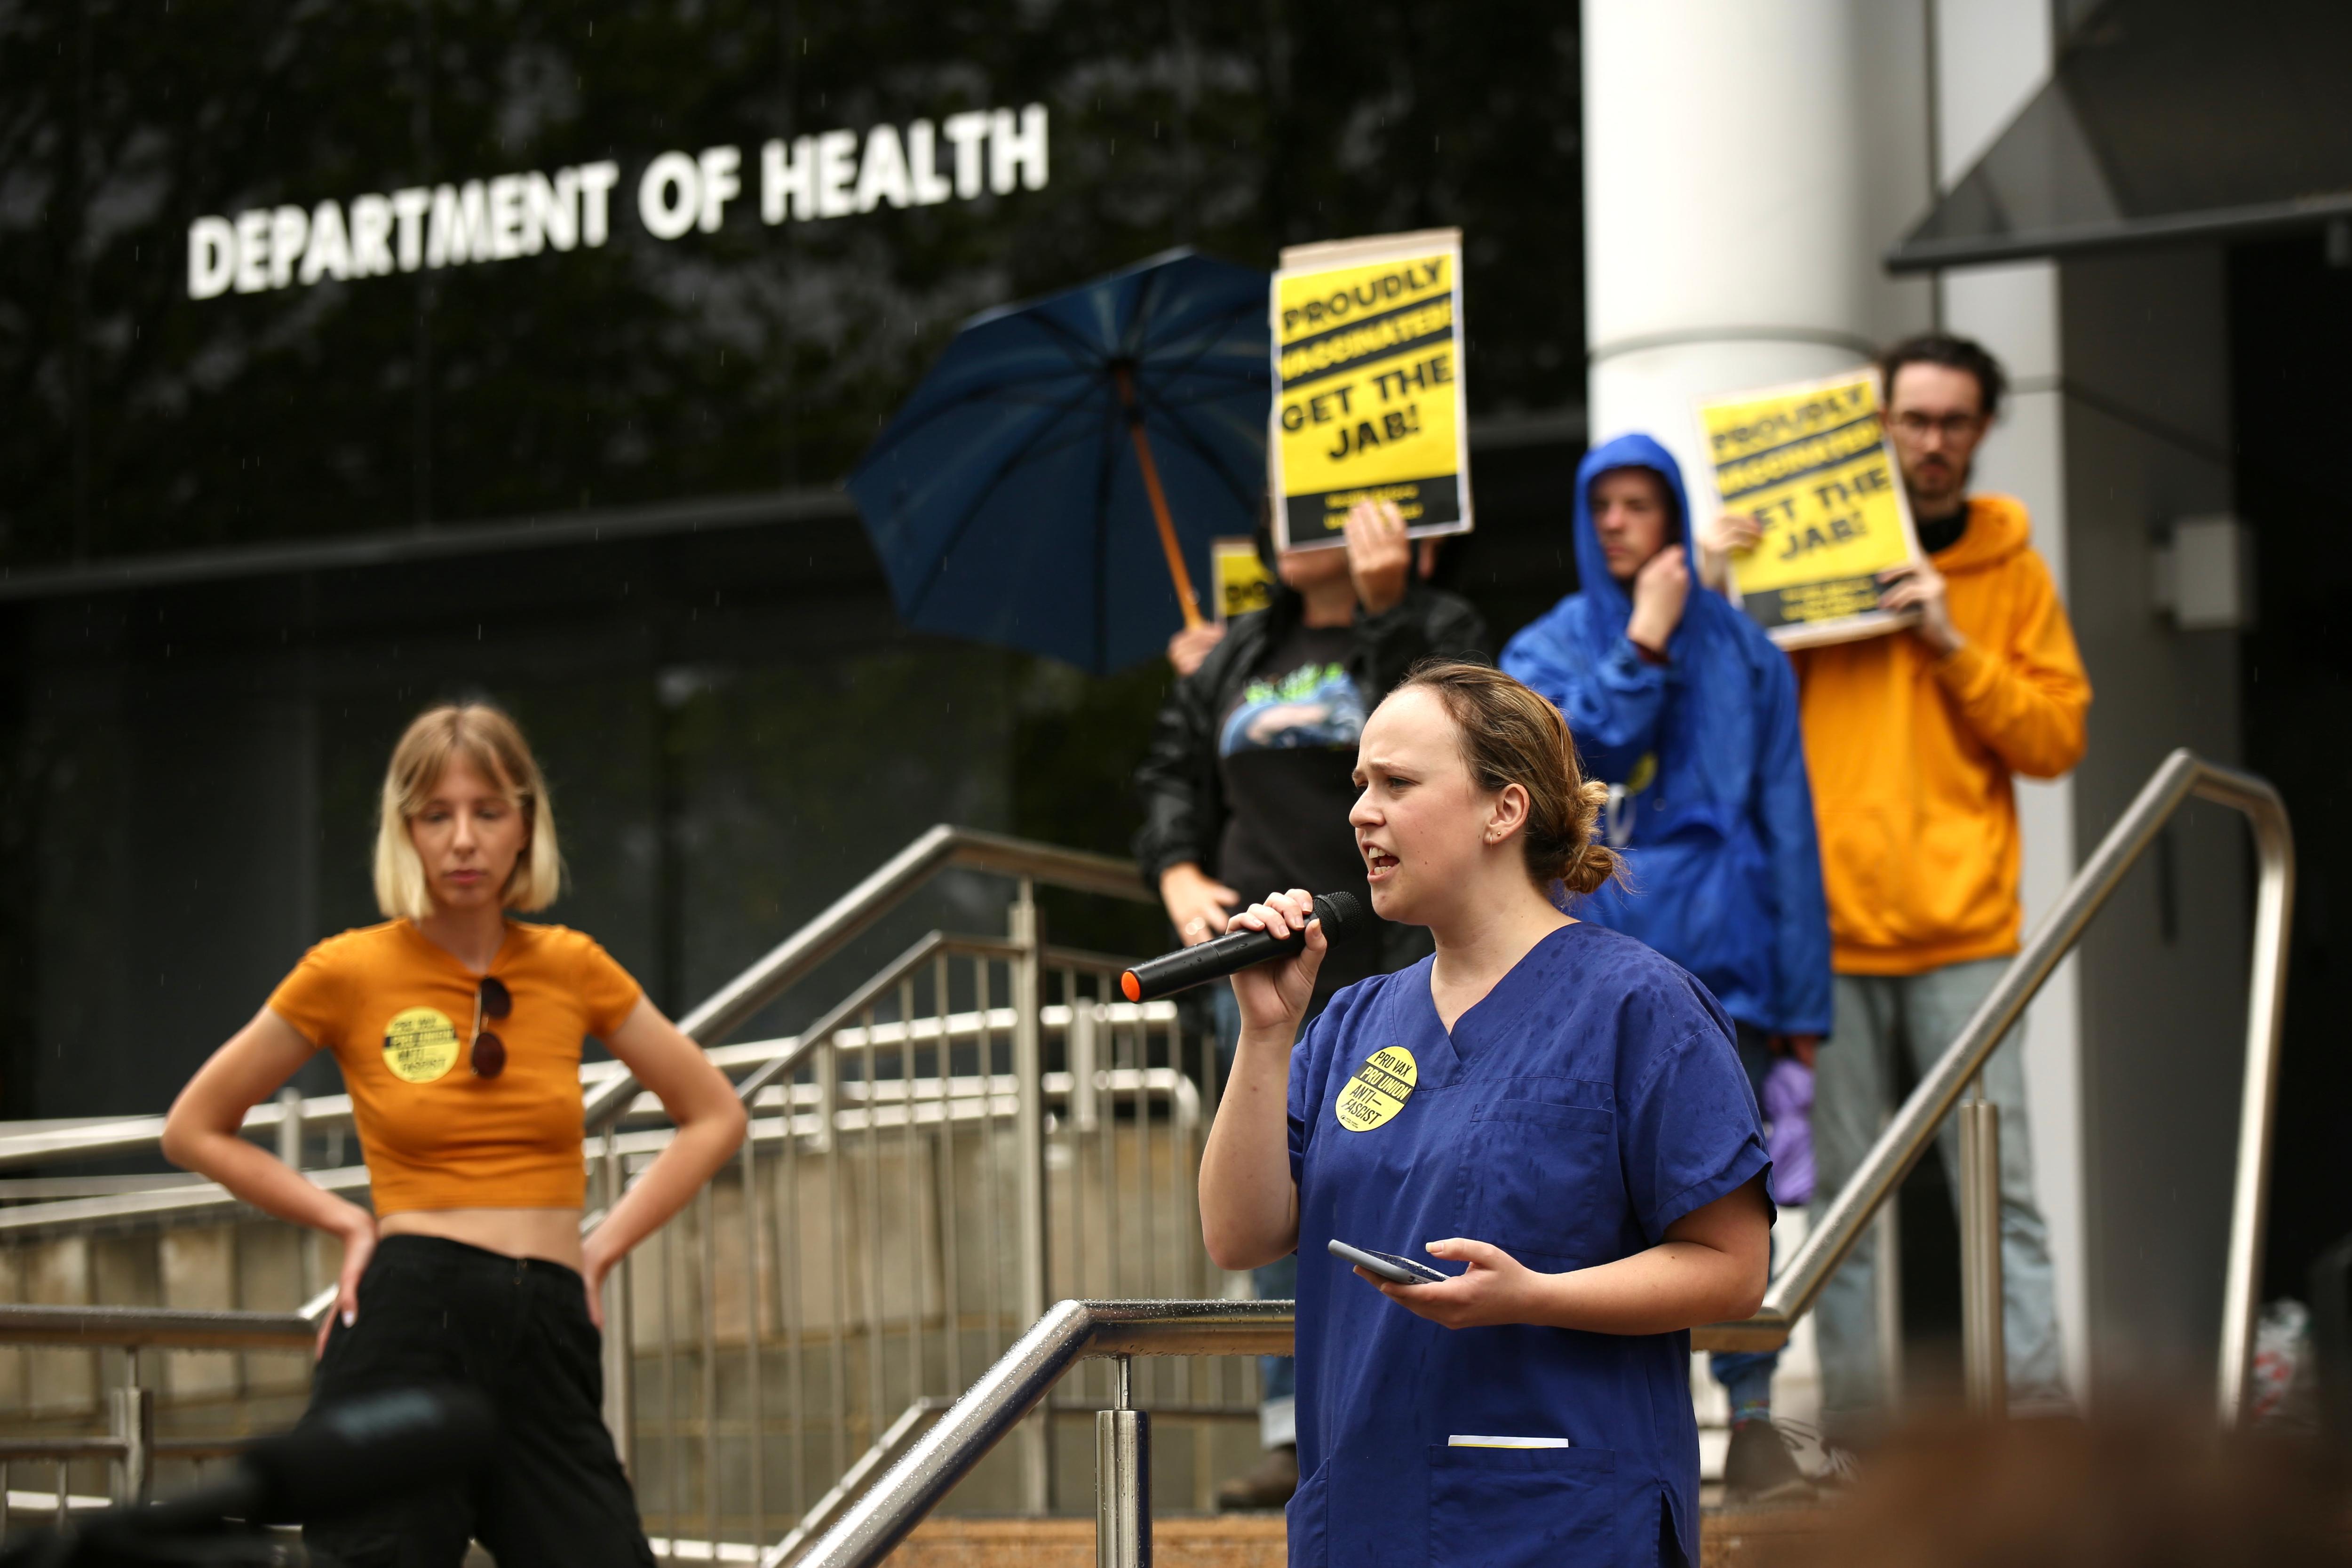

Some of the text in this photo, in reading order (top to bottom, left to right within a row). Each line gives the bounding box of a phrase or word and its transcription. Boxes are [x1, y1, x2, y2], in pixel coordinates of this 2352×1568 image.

[187, 103, 1049, 299] DEPARTMENT OF HEALTH
[1282, 260, 1443, 330] PROUDLY
[1281, 352, 1455, 432] GET THE
[1327, 404, 1421, 462] JAB!
[1710, 386, 1864, 454] PROUDLY
[1813, 467, 1893, 510] THE
[1359, 1066, 1412, 1101] PRO UNION
[1374, 1051, 1413, 1077] PRO VAX
[1341, 1098, 1383, 1125] FASCIST
[1349, 1084, 1382, 1106] ANTI-
